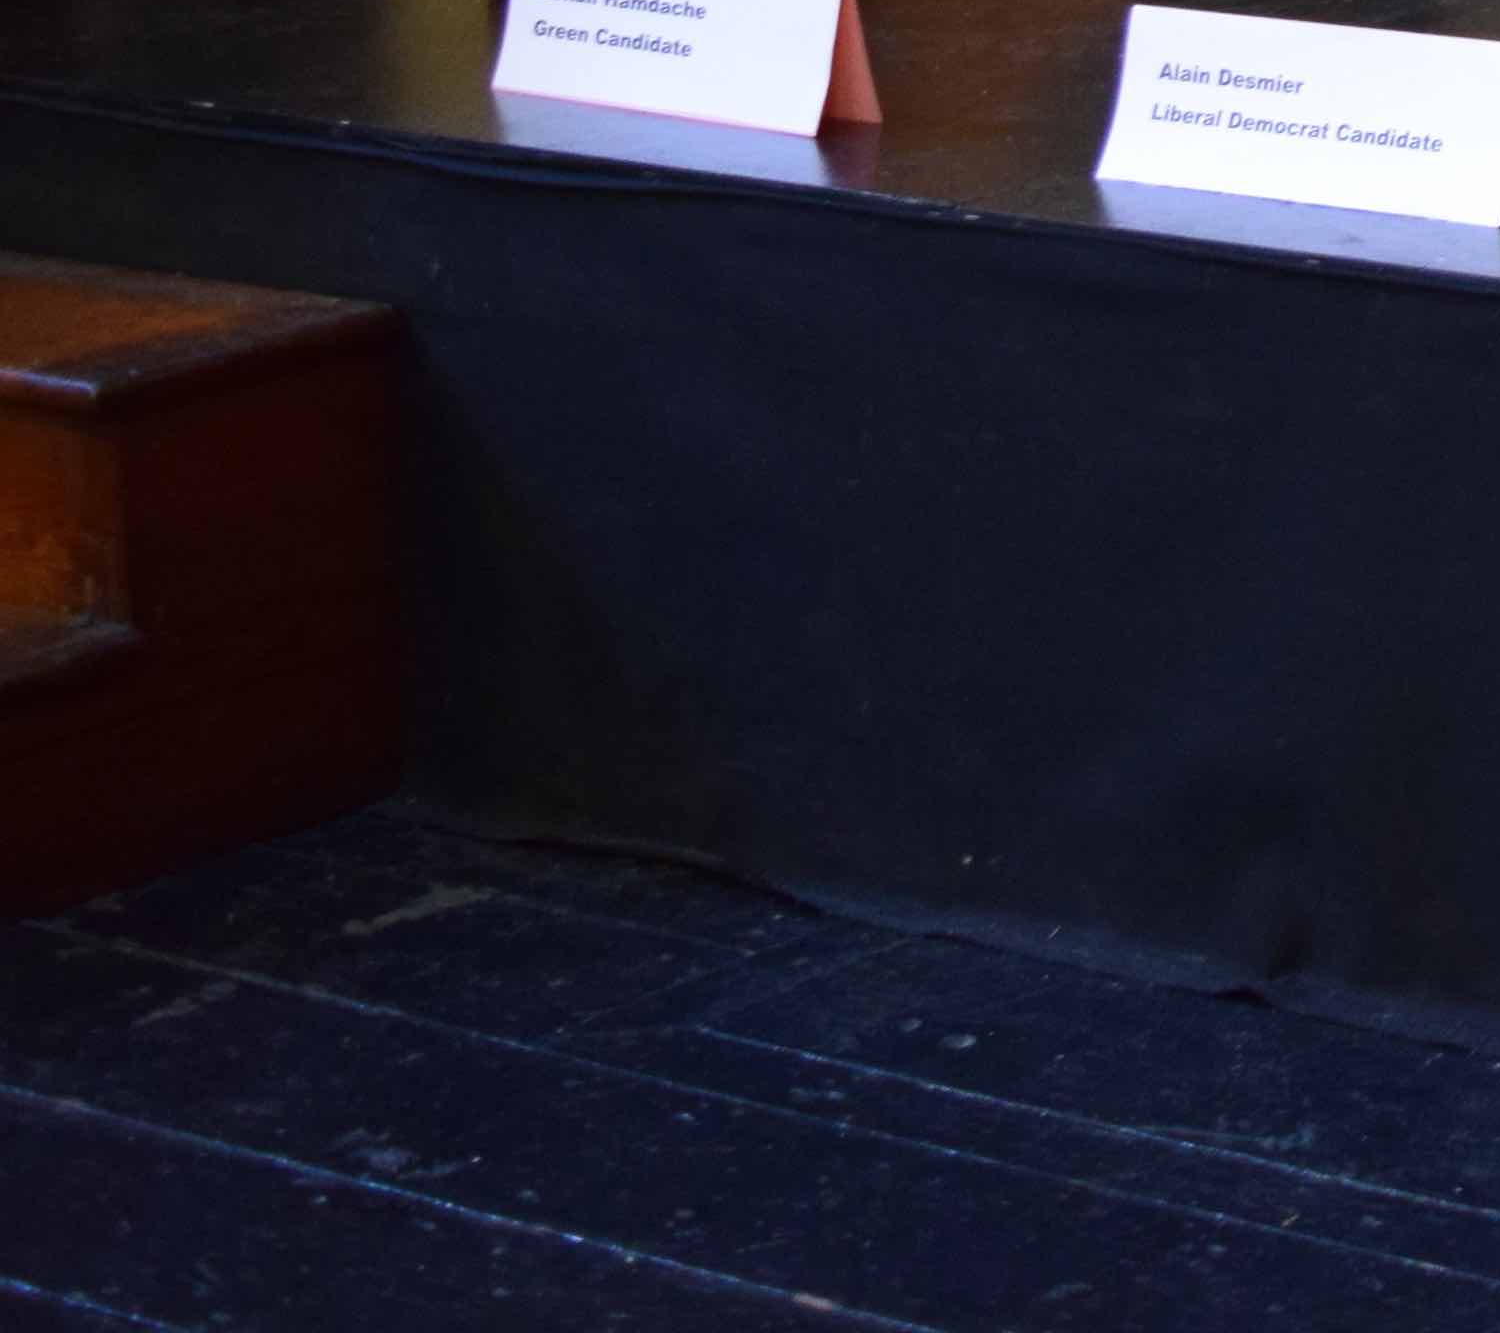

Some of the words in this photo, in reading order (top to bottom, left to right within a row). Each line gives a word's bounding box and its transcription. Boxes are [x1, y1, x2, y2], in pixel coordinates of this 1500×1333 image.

[532, 18, 590, 44] Green
[594, 28, 693, 58] Candidate
[1157, 62, 1211, 85] Alain
[1217, 68, 1305, 94] Desmier
[1151, 102, 1223, 128] Liberal
[1226, 111, 1331, 141] Democrat
[1335, 123, 1444, 153] Candidate
